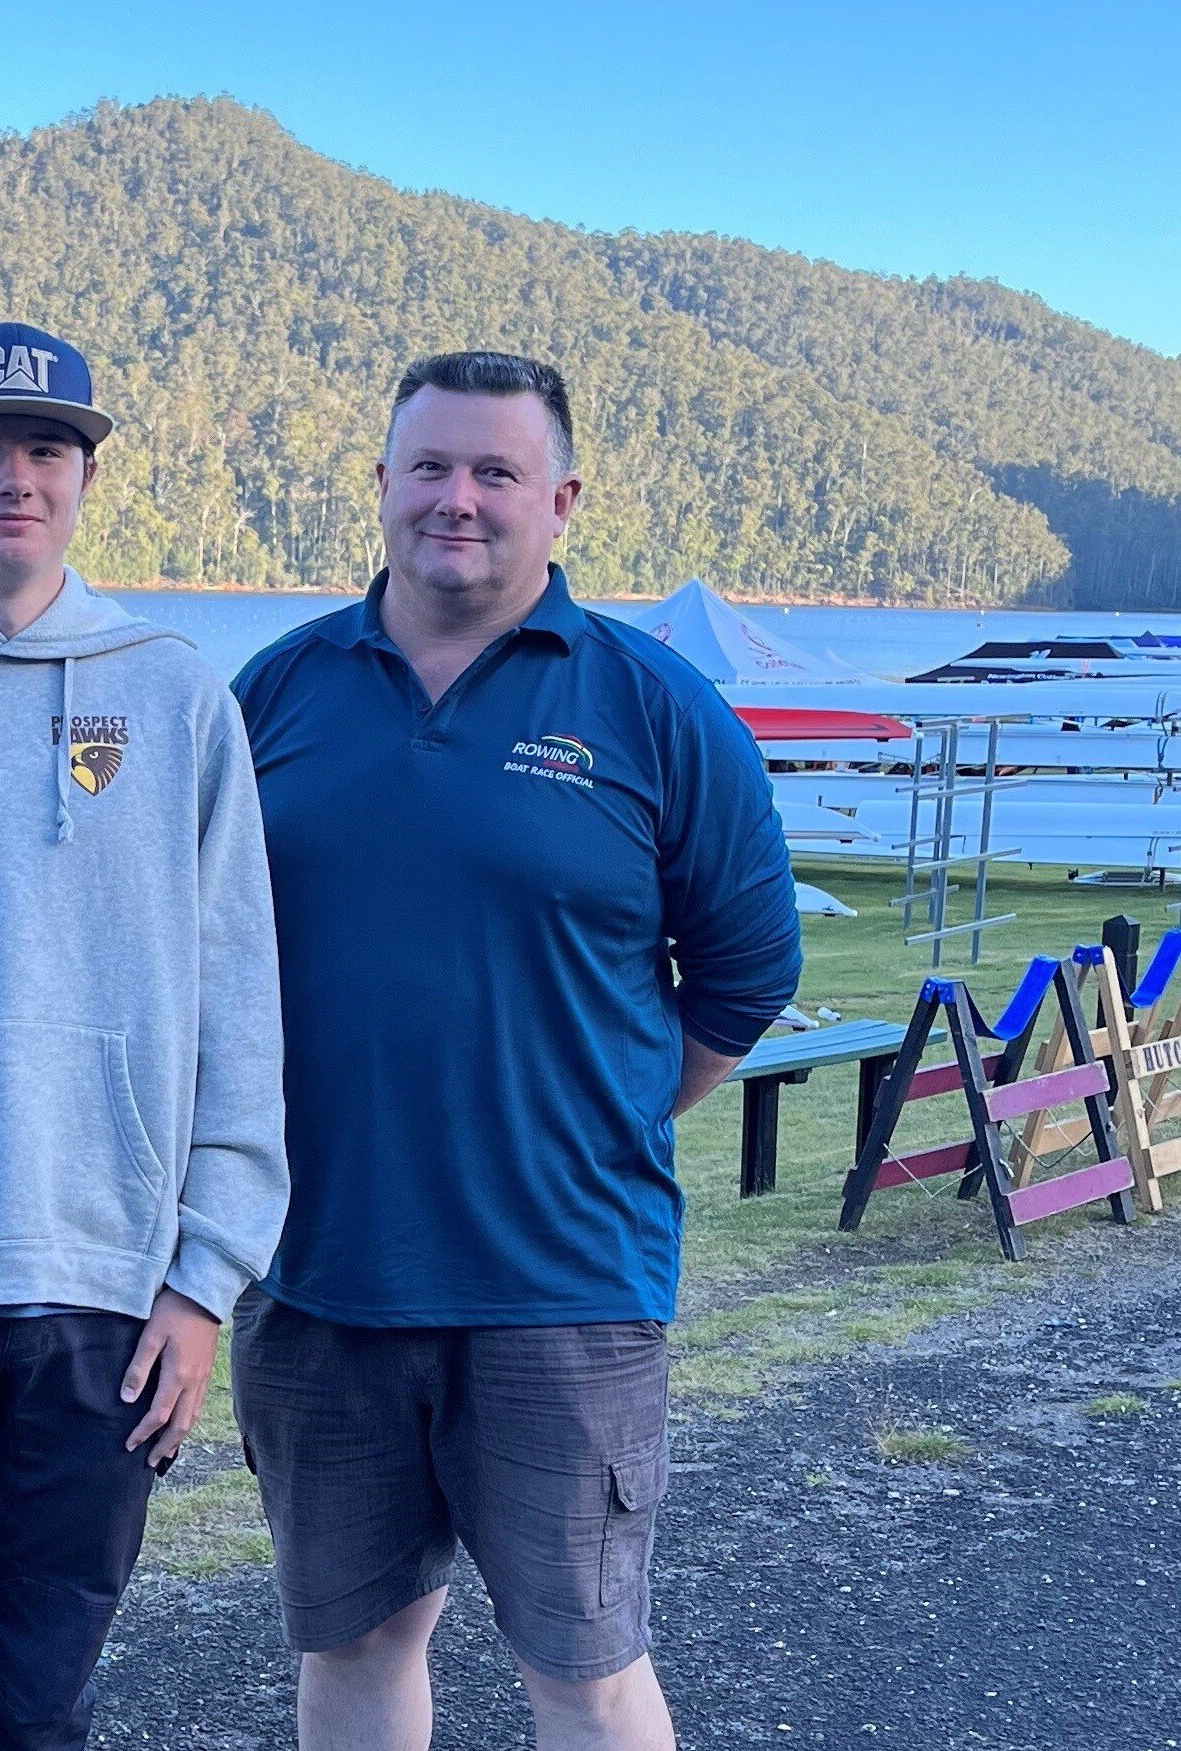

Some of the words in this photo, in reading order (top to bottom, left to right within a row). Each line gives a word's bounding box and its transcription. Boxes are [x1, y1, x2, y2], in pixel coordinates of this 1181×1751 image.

[512, 742, 579, 765] ROWING
[503, 762, 530, 773] BOAT
[530, 766, 554, 779] RACE
[555, 773, 594, 789] OFFICIAL
